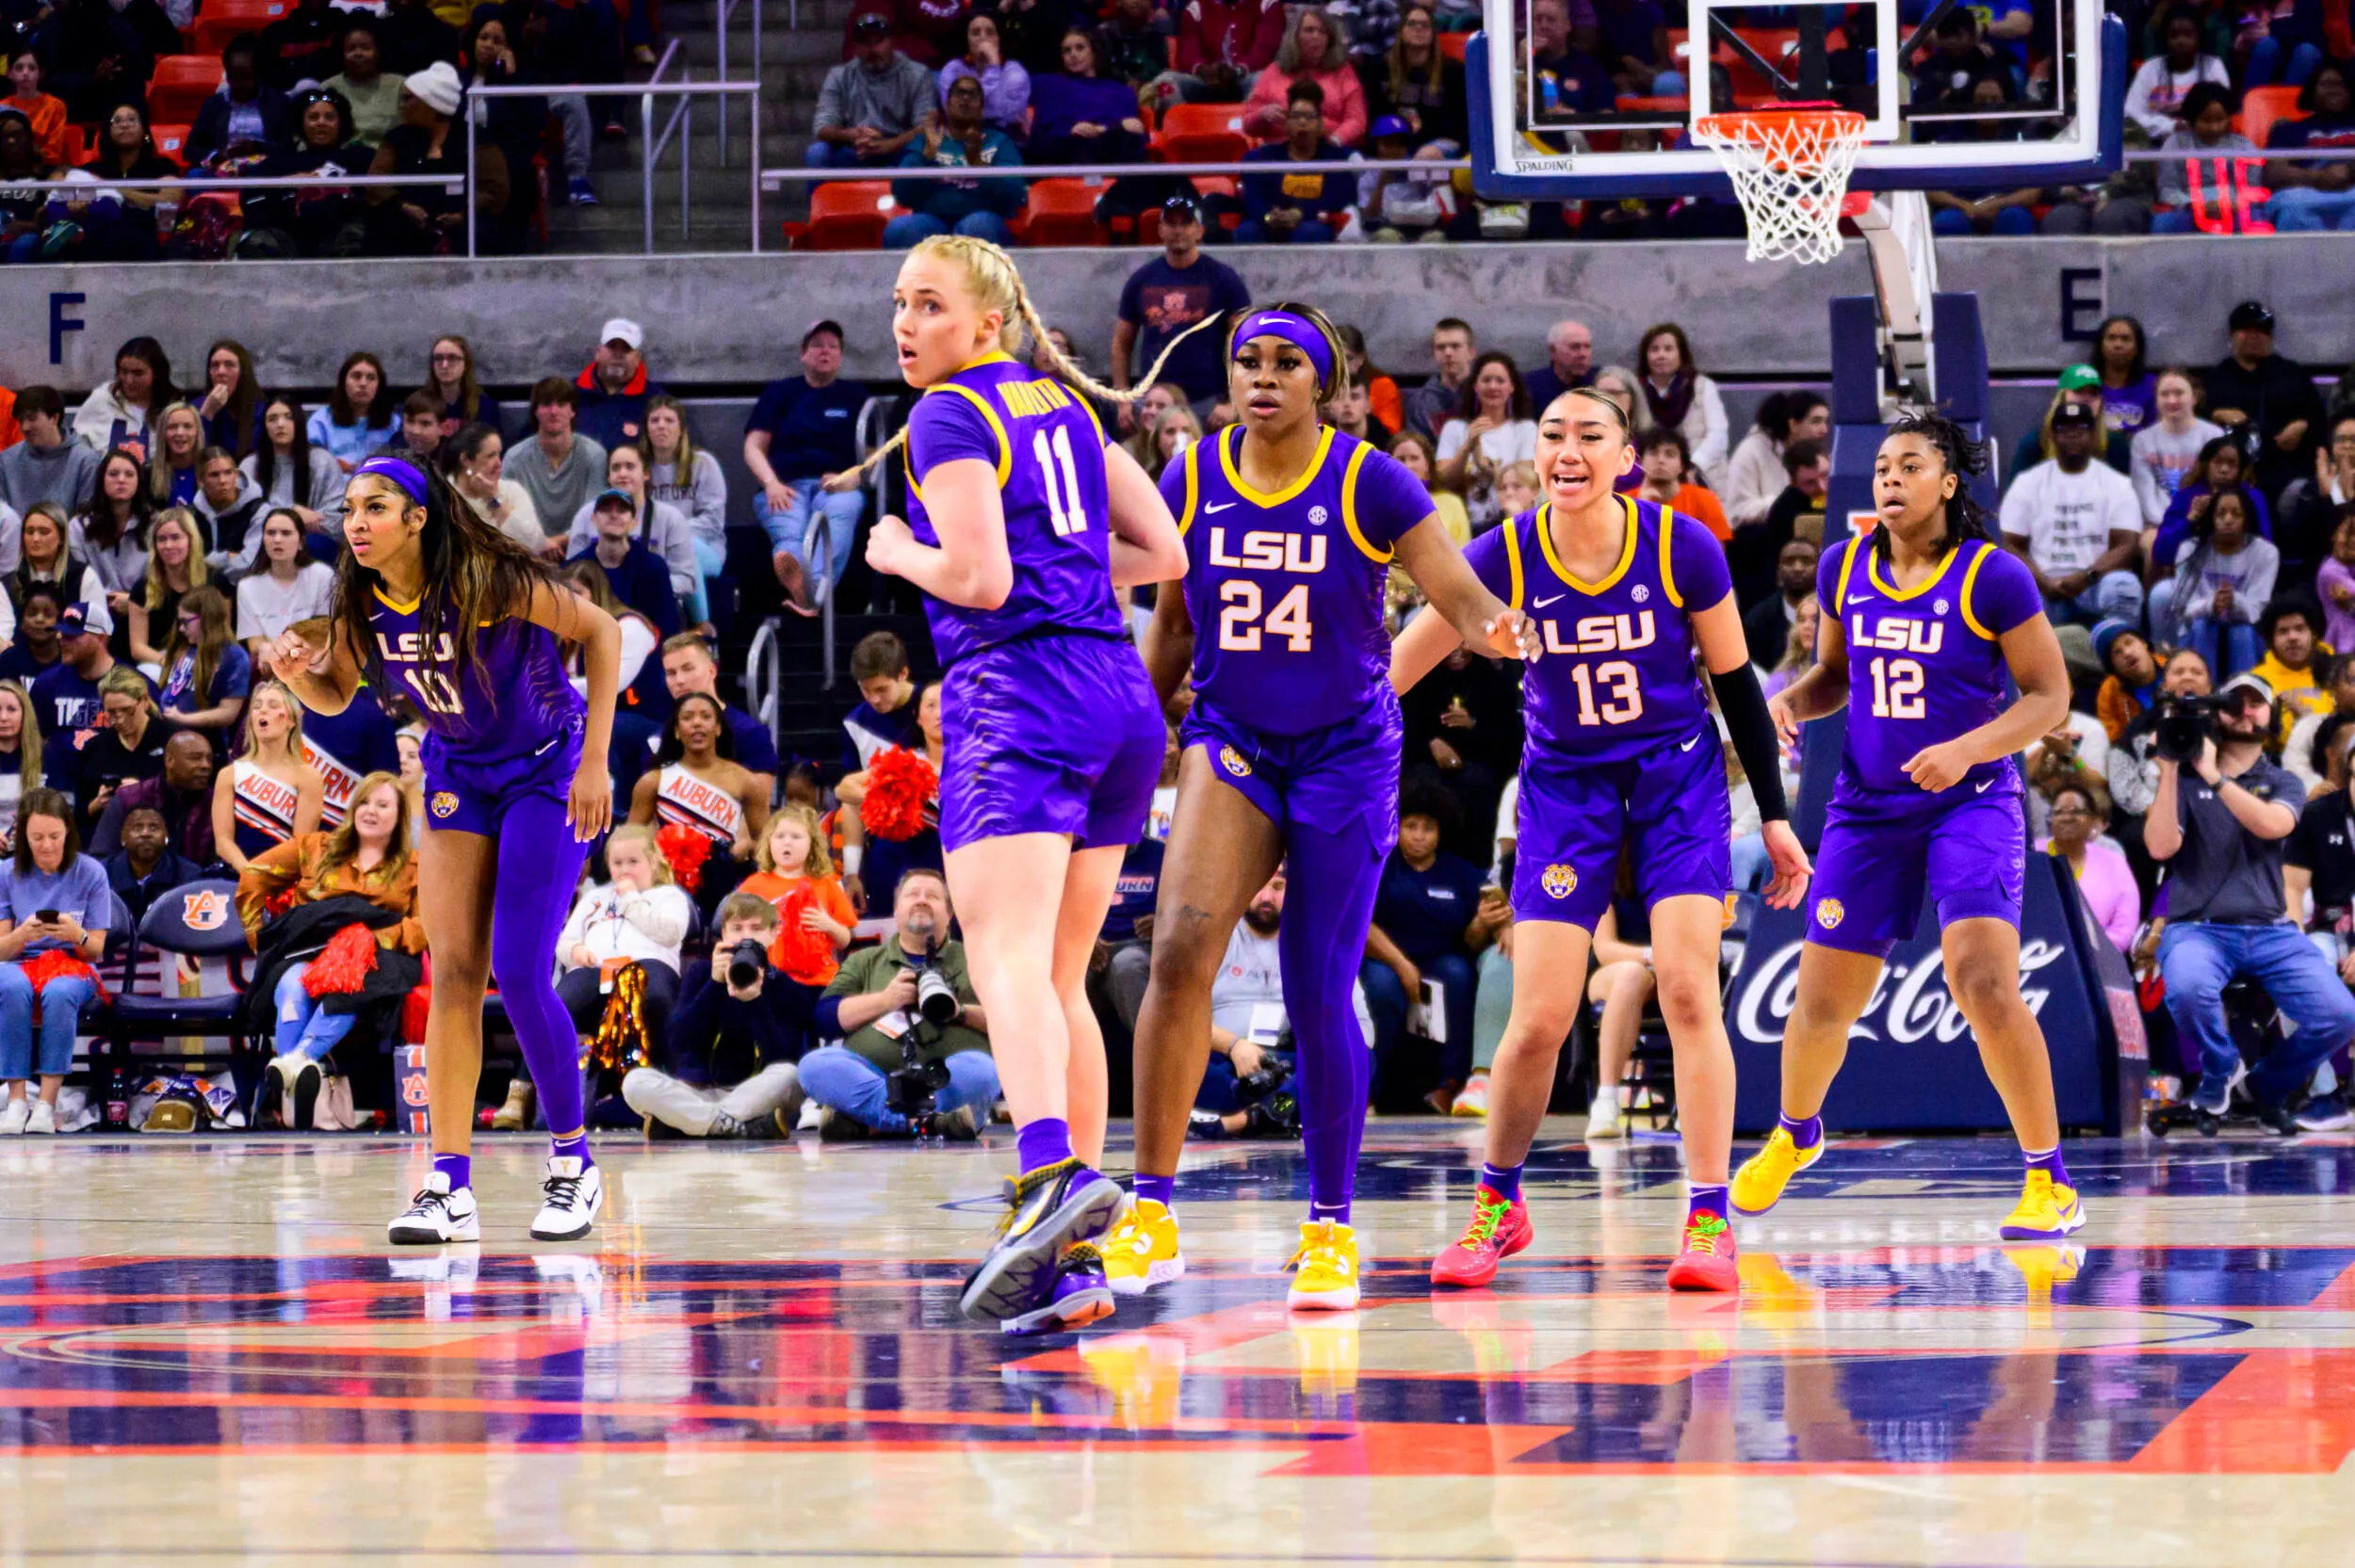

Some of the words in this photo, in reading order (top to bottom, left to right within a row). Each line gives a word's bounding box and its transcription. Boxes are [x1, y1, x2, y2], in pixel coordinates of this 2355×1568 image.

[1516, 159, 1573, 173] SPALDING
[50, 292, 85, 364] F
[2061, 268, 2101, 341] E
[1032, 425, 1087, 537] 11
[1210, 526, 1327, 574] LSU
[1219, 579, 1312, 652] 24
[1542, 609, 1656, 654] LSU
[1852, 614, 1943, 654] LSU
[1571, 660, 1643, 725] 13
[1870, 656, 1925, 719] 12
[237, 773, 298, 817] AUBUR
[666, 775, 737, 829] AUBURN
[1737, 940, 2065, 1043] Co-Co
